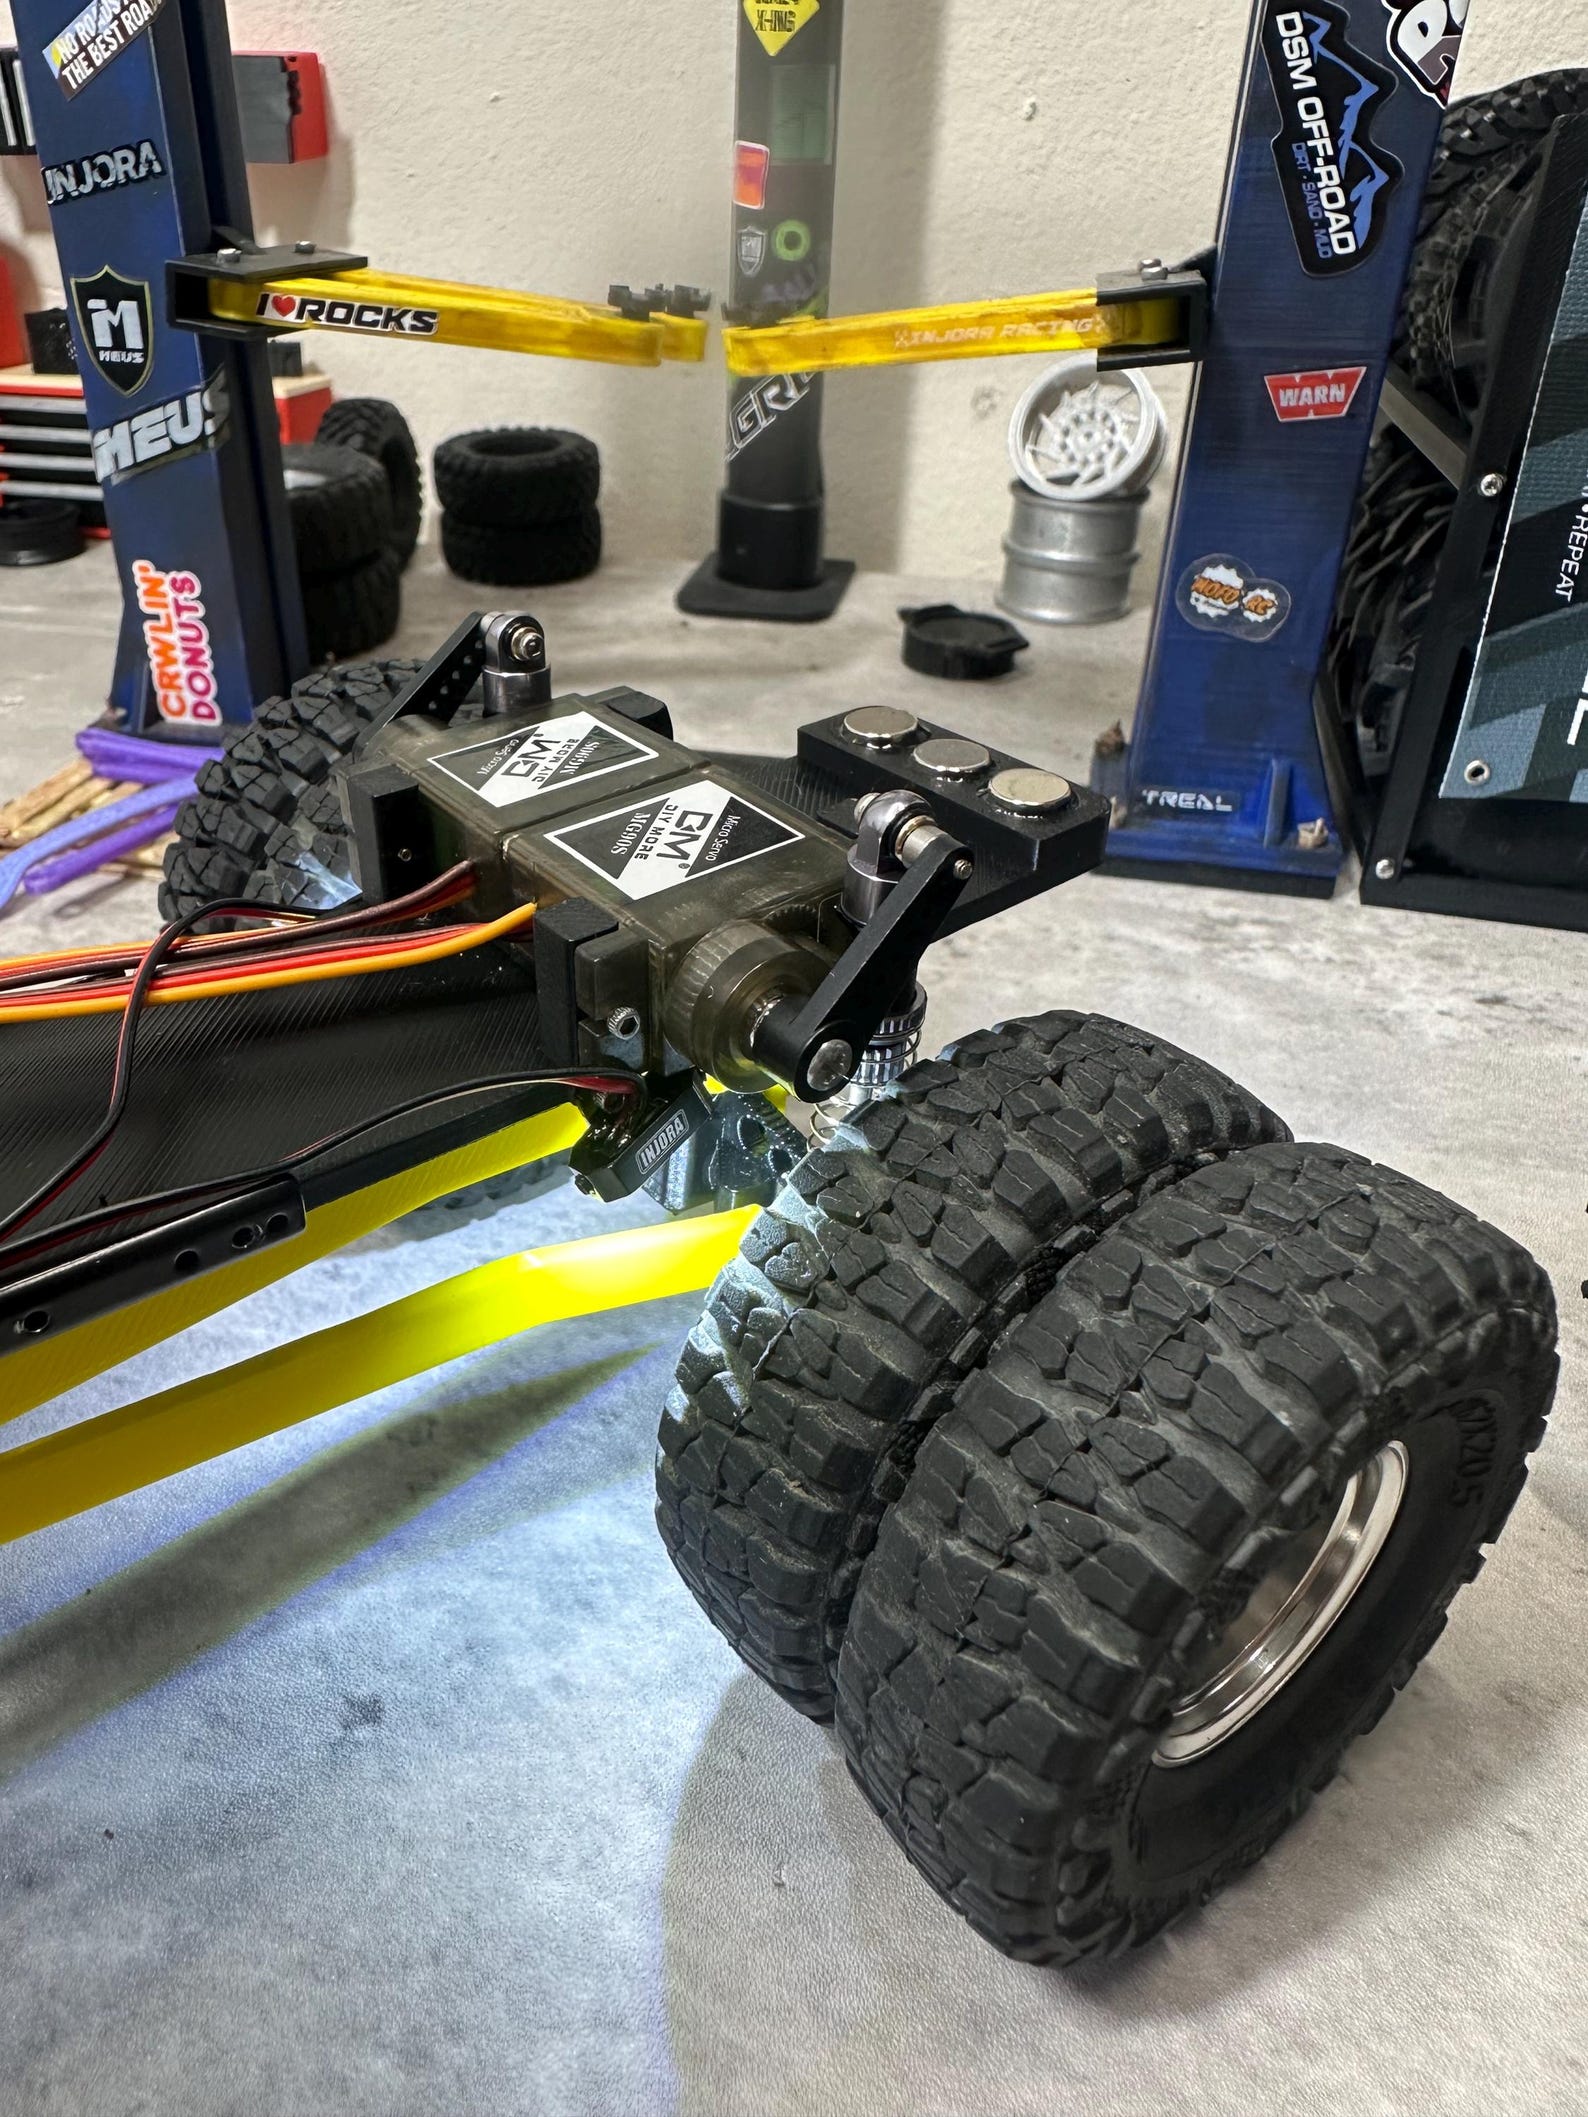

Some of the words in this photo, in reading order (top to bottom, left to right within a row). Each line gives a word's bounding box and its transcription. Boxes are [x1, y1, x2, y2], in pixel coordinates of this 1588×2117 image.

[55, 33, 80, 64] NO
[61, 51, 94, 90] THE
[86, 20, 125, 67] BEST
[1276, 11, 1317, 90] DSM
[1297, 96, 1356, 255] OFF-ROAD
[1313, 227, 1332, 259] MUD
[256, 293, 270, 316] I
[295, 298, 438, 333] ROCKS
[1279, 383, 1346, 407] WARN
[1555, 514, 1588, 602] REPEAT
[169, 575, 216, 722] DONUTS
[1142, 789, 1233, 812] TREAL
[610, 812, 651, 855] MG90S
[634, 826, 665, 860] MORE
[640, 1117, 684, 1166] INJORA
